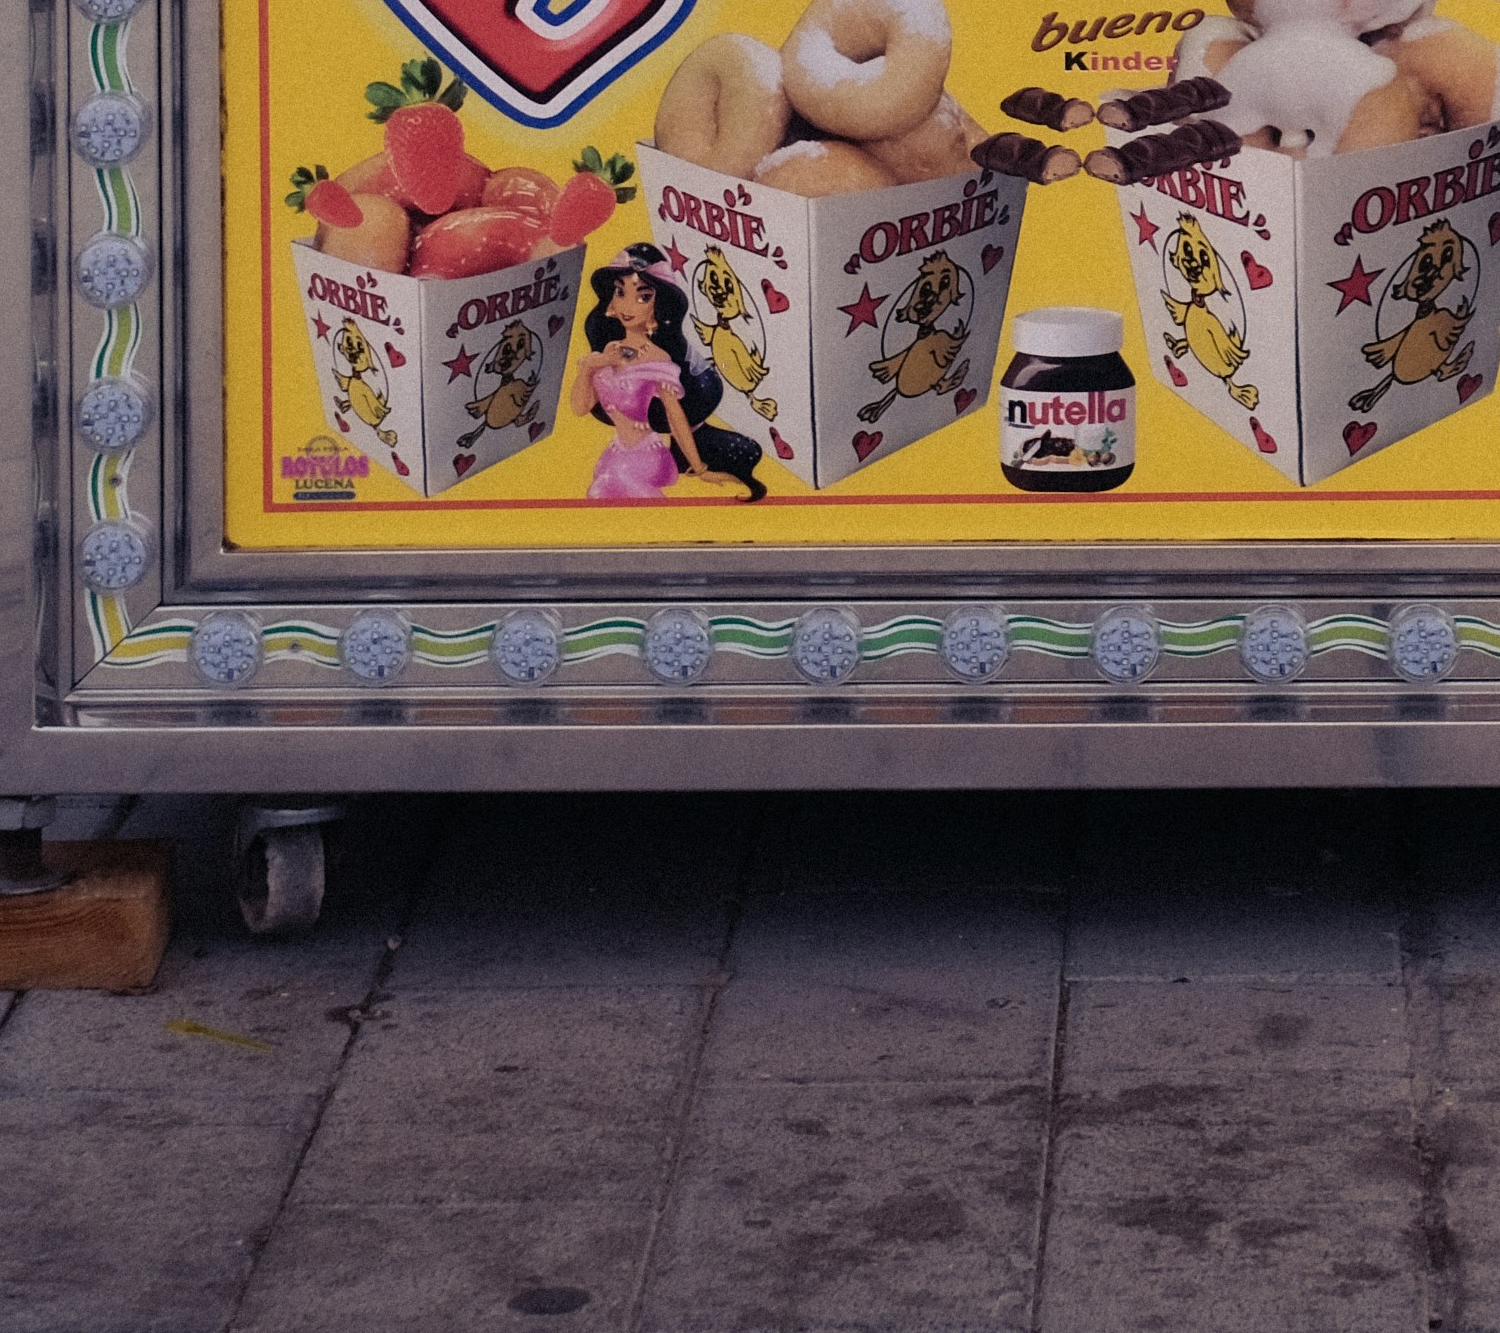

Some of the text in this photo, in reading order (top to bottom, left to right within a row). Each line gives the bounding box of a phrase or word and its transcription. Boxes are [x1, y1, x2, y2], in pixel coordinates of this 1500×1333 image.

[1031, 8, 1205, 52] bueno
[1064, 51, 1178, 72] Kinder
[662, 184, 770, 257] ORBIE
[859, 179, 999, 263] ORBIE
[1141, 163, 1250, 227] RBIE
[310, 273, 390, 326] ORBIE
[457, 267, 560, 331] ORBIE
[1008, 391, 1127, 426] nutella
[295, 478, 355, 490] LUCENA
